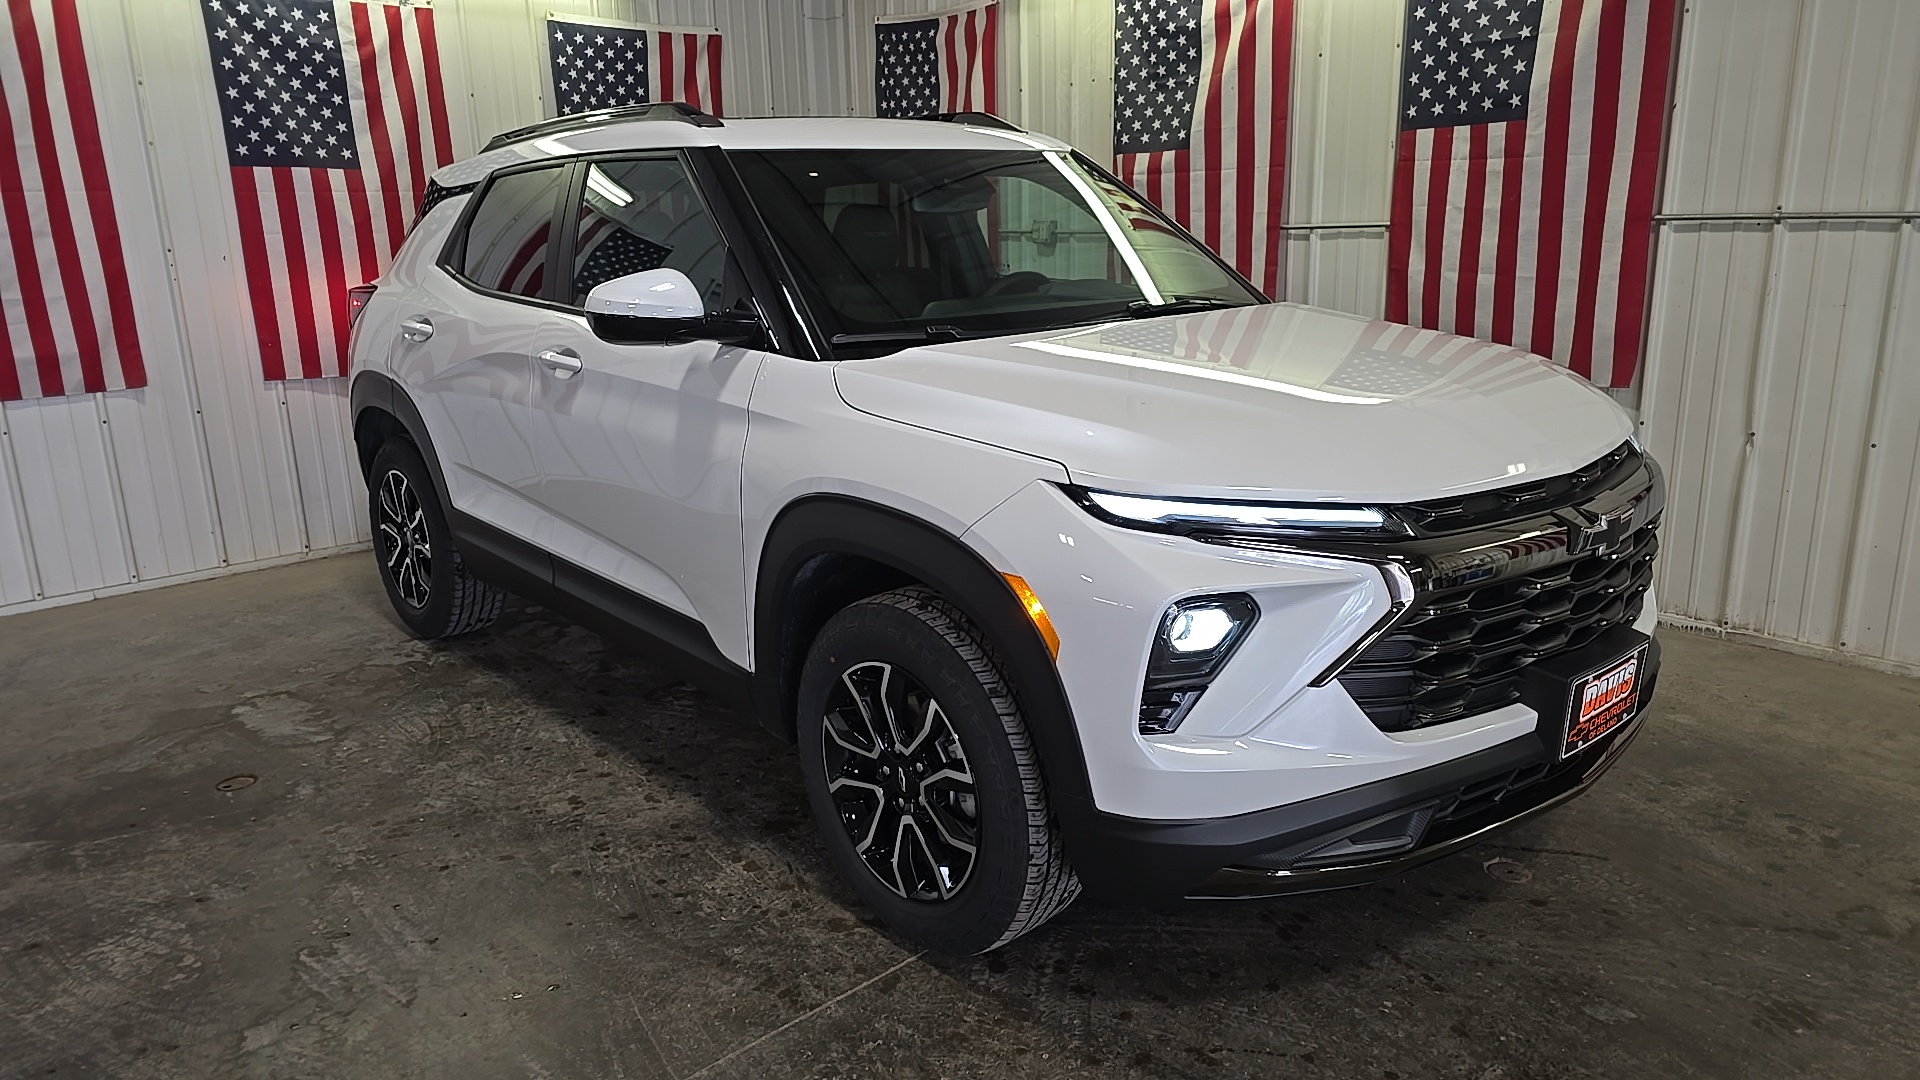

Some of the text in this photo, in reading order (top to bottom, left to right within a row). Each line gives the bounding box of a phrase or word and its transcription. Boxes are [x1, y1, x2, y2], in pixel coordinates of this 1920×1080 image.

[1582, 662, 1636, 718] DAVIS
[1588, 718, 1618, 740] OF DELANO
[1589, 692, 1637, 730] CHEVROLET
